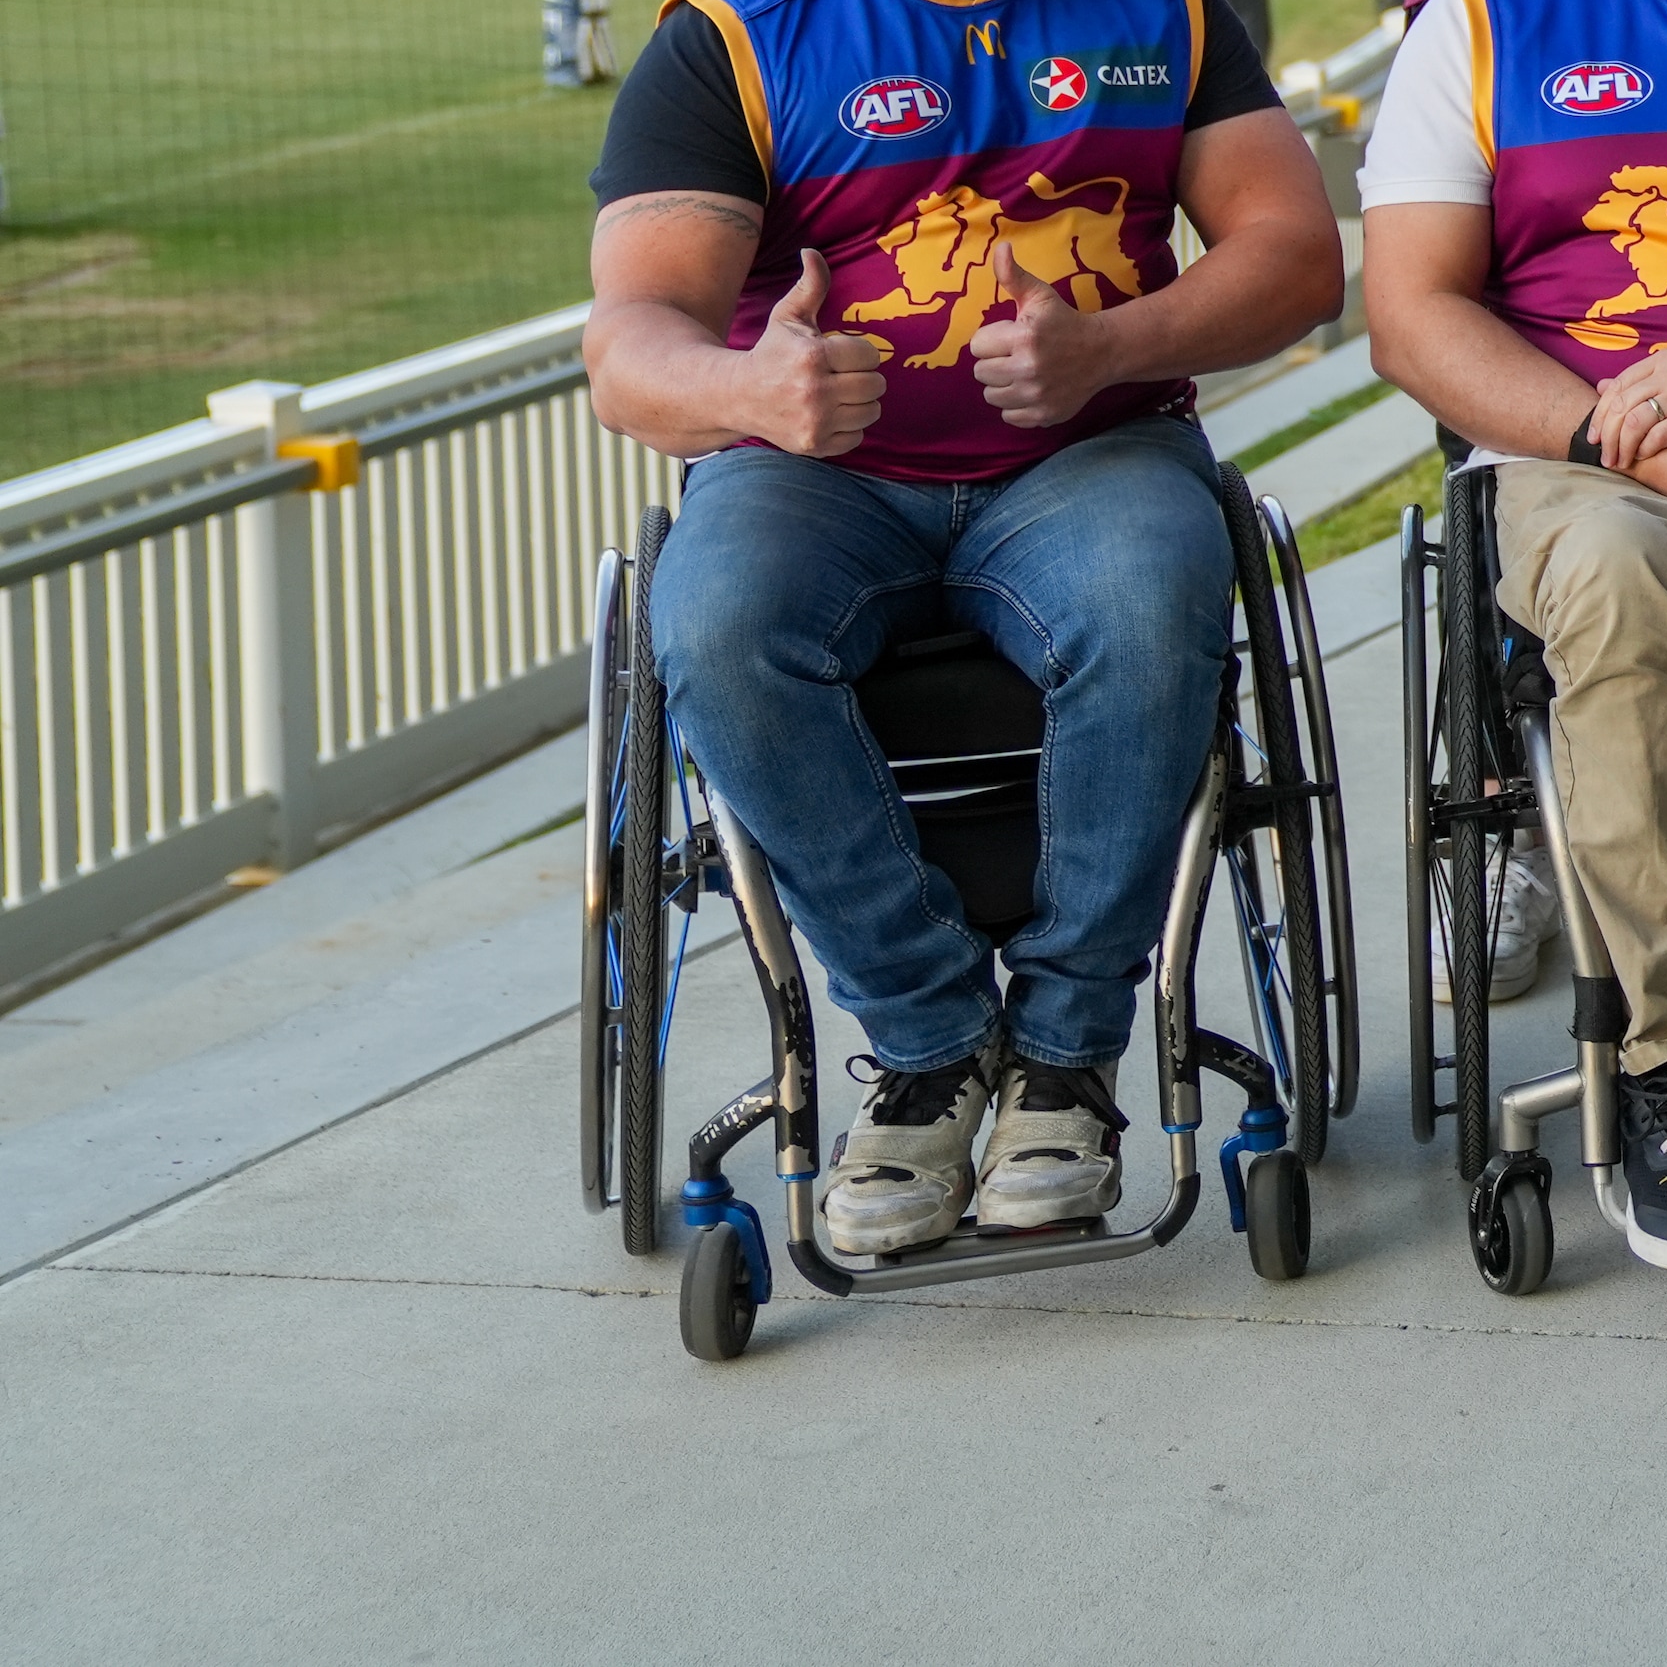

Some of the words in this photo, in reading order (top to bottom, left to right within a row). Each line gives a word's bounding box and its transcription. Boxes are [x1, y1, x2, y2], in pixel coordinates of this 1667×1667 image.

[1098, 65, 1171, 87] CALTEX
[1552, 73, 1643, 103] AFL
[853, 88, 944, 129] AFL
